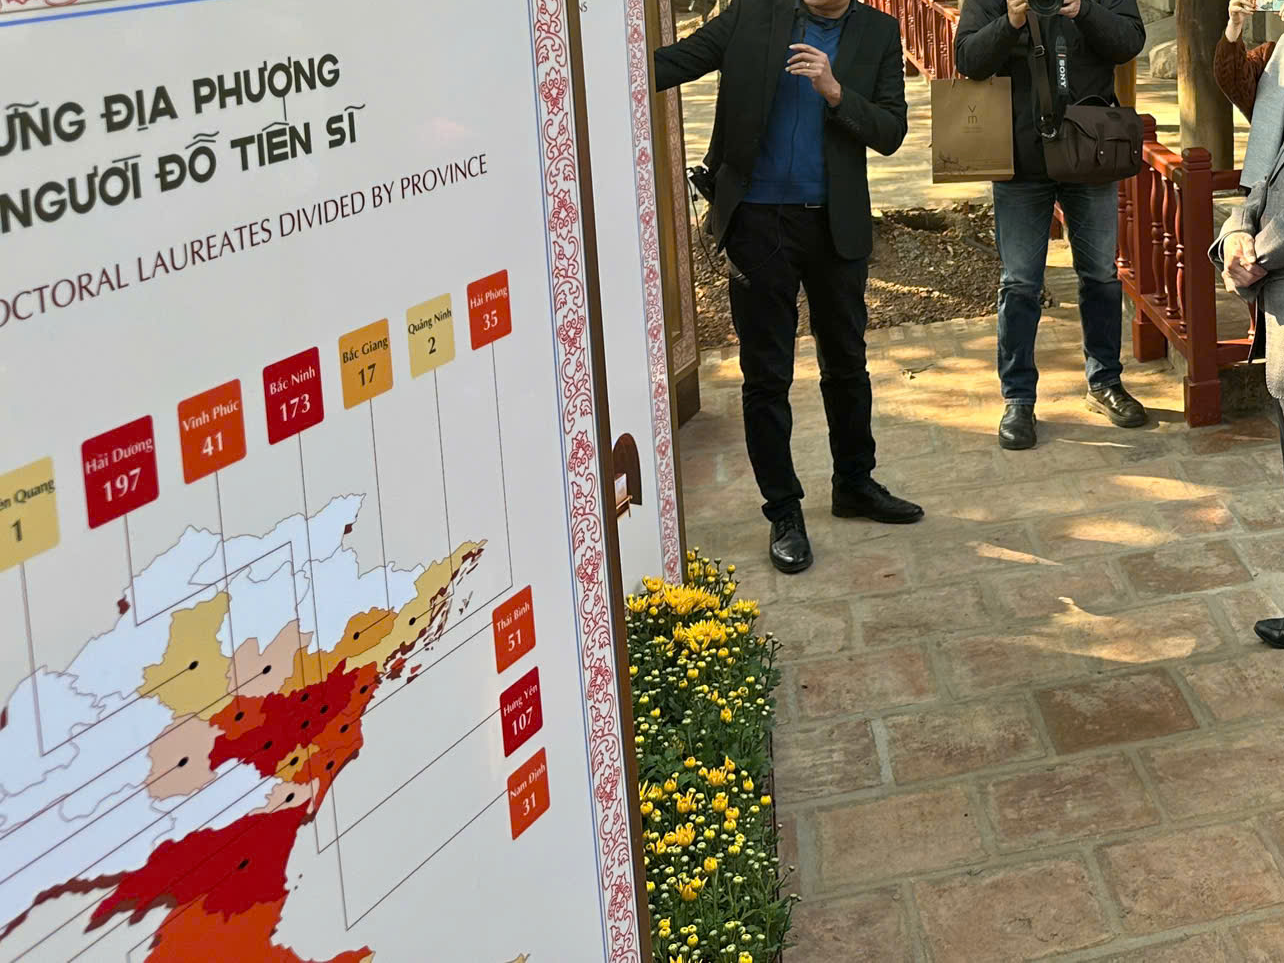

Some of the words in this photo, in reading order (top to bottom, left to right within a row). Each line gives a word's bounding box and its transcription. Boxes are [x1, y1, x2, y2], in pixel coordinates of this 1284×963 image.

[1058, 59, 1067, 88] SONY
[100, 85, 178, 131] ĐỊA
[192, 53, 340, 114] PHƯƠNG
[325, 103, 366, 149] SĨ
[137, 218, 272, 282] LAUREATES
[279, 190, 366, 237] DIVIDED
[371, 180, 399, 209] BY
[400, 153, 488, 199] PROVINCE
[434, 308, 452, 324] Ninh
[482, 309, 499, 331] 35
[342, 346, 359, 364] Bắc
[361, 337, 389, 355] Giang
[428, 336, 437, 355] 2
[269, 376, 288, 395] Bắc
[291, 366, 316, 384] Ninh
[358, 363, 377, 387] 17
[213, 398, 240, 416] Phúc
[279, 393, 311, 422] 173
[202, 431, 224, 457] 41
[14, 479, 56, 504] Quang
[103, 467, 142, 502] 197
[11, 518, 23, 542] 1
[496, 613, 512, 633] Thái
[508, 628, 522, 652] 51
[523, 684, 538, 700] Yên
[511, 705, 533, 736] 107
[509, 780, 527, 800] Nam
[522, 792, 537, 816] 31
